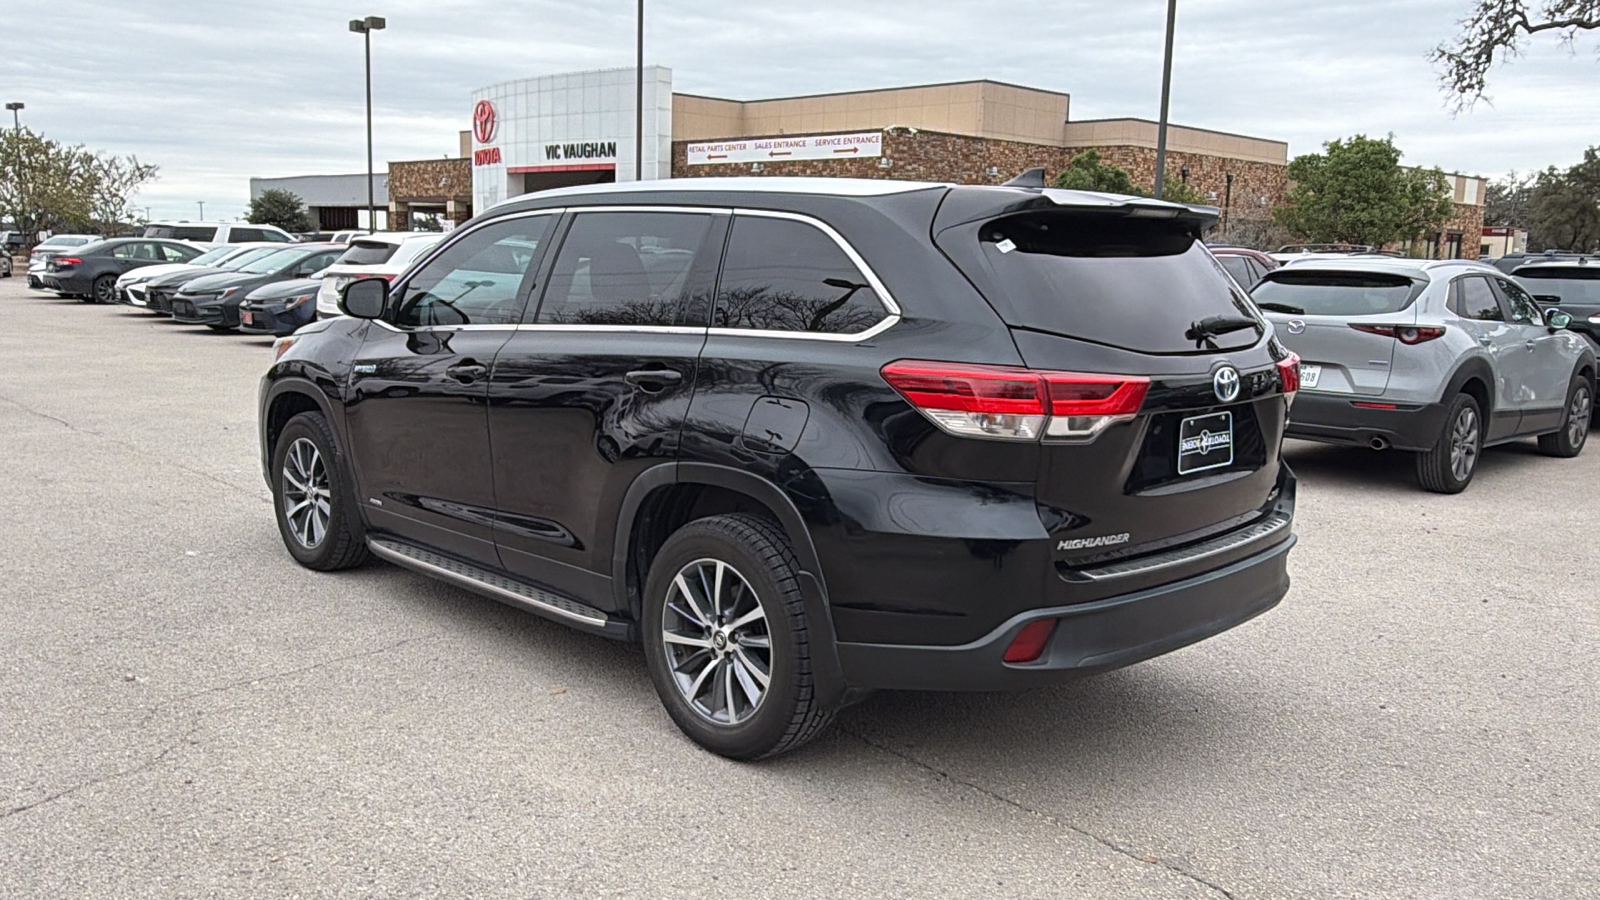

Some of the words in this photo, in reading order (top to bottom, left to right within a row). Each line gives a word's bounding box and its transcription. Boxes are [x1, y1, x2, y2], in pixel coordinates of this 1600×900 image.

[754, 141, 772, 150] SALES
[774, 140, 806, 148] ENTRANCE
[815, 137, 841, 146] SERVICE
[843, 135, 880, 145] ENTRANCE
[545, 144, 560, 160] VIC
[563, 142, 617, 159] VAUGHAN
[689, 145, 705, 153] RETAIL
[707, 144, 723, 152] PARTS
[725, 143, 747, 151] CENTER
[475, 149, 501, 165] TOYOTA
[1057, 534, 1130, 550] HIGHLANDER
